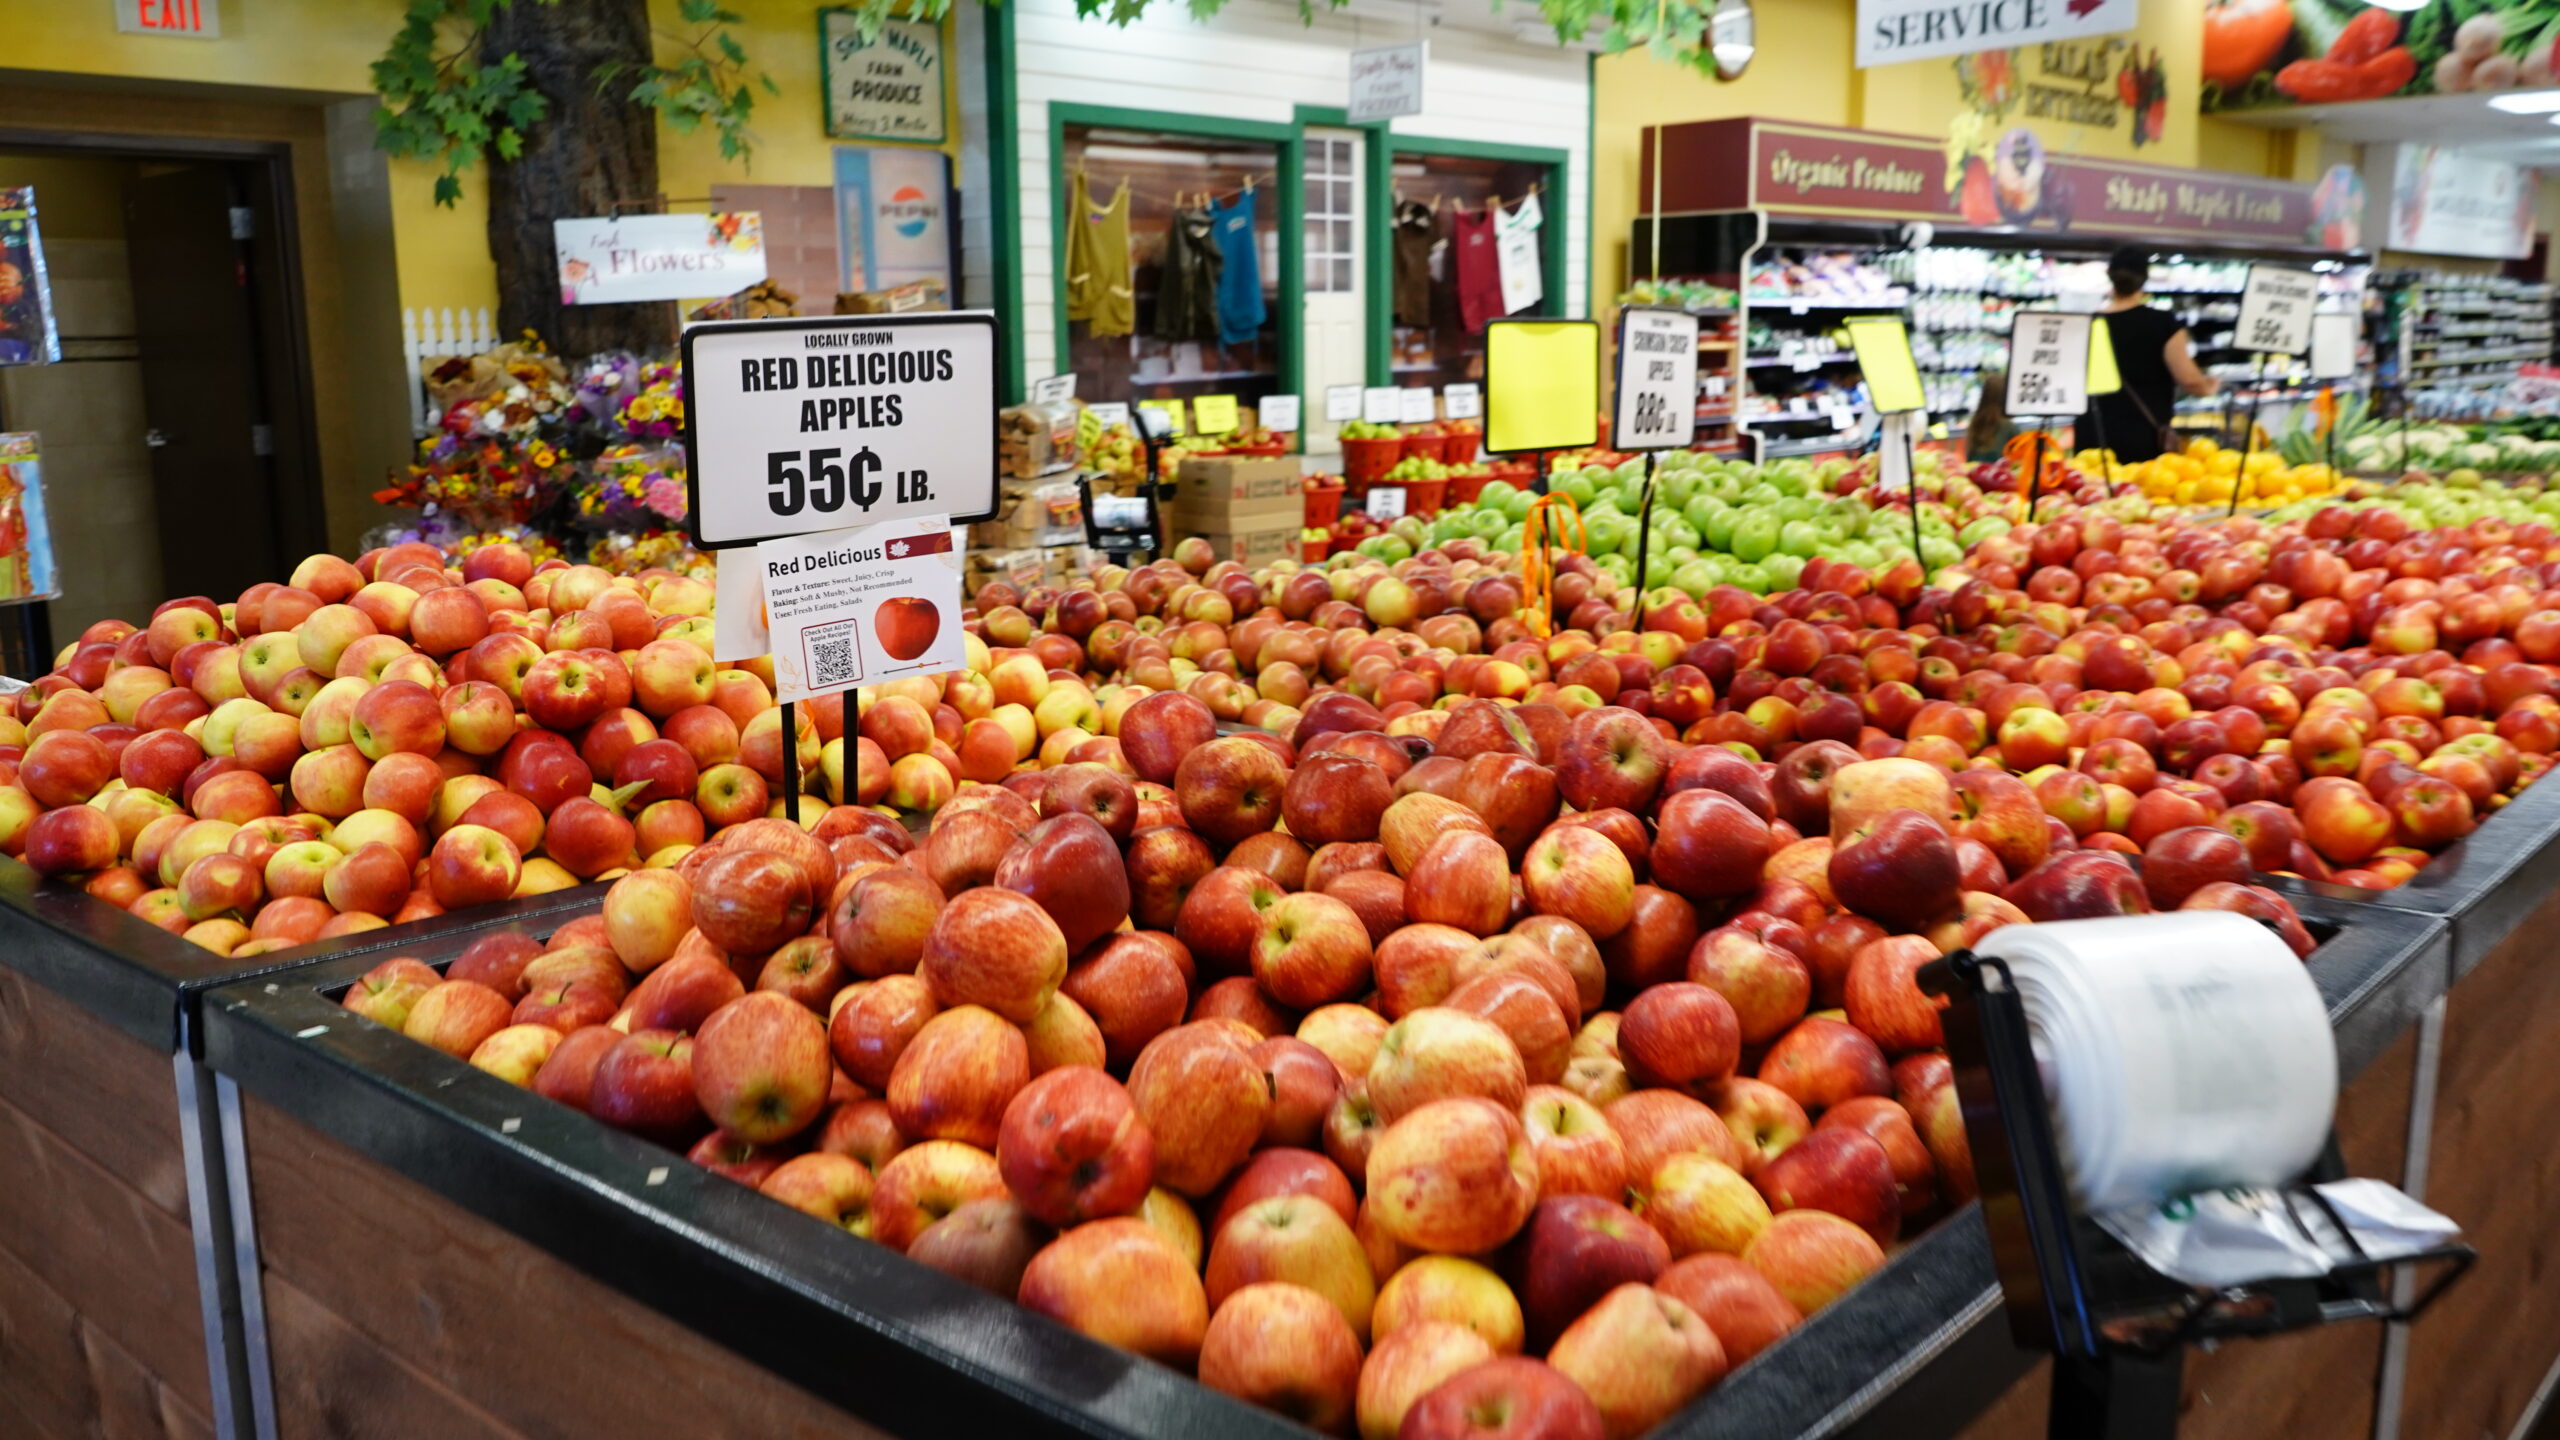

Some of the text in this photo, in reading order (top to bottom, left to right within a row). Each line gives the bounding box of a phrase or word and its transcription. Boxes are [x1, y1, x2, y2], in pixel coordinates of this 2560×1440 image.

[1874, 0, 2048, 49] SERVICE
[852, 79, 922, 104] PRODUCE
[1771, 149, 1924, 194] Organic Produce
[879, 204, 938, 217] PEPSI
[2105, 175, 2168, 224] Shady
[610, 249, 726, 275] Flowers
[805, 331, 893, 348] LOCALLY GROWN
[741, 349, 953, 392] RED DELICIOUS
[800, 394, 903, 432] APPLES
[1634, 392, 1666, 435] 88¢
[768, 446, 935, 516] 55¢ LB.
[768, 547, 881, 577] Red Delicious
[772, 587, 795, 597] Flavor
[802, 580, 830, 591] Texture:
[875, 570, 895, 578] Crisp
[773, 597, 799, 608] Baking:
[849, 585, 862, 593] Not
[863, 577, 912, 592] Recommended
[774, 611, 792, 620] Uses:
[793, 606, 813, 616] Fresh
[839, 597, 863, 607] Salads
[804, 628, 821, 637] Check
[810, 634, 827, 642] Apple
